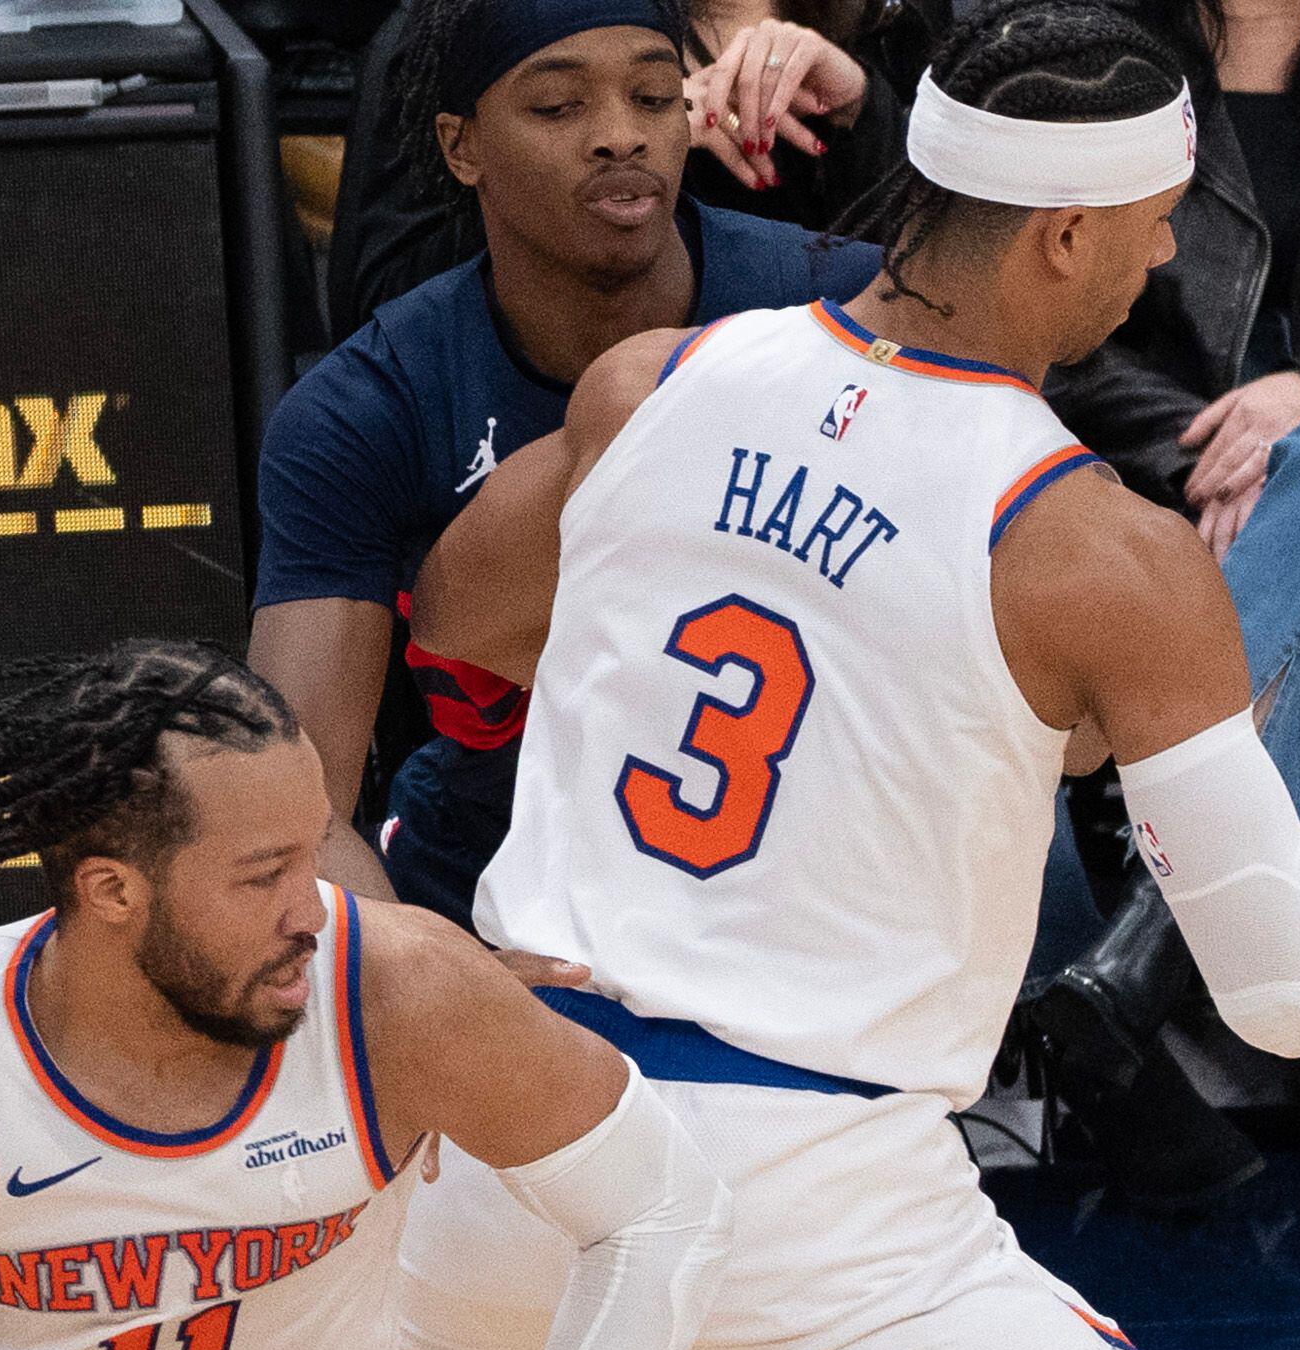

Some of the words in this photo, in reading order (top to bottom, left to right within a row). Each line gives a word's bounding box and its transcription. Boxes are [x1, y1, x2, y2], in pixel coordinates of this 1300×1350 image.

[713, 448, 899, 588] HART
[614, 593, 816, 881] 3
[245, 1148, 285, 1169] abu
[288, 1127, 347, 1158] dhabi
[177, 1199, 371, 1301] YORK
